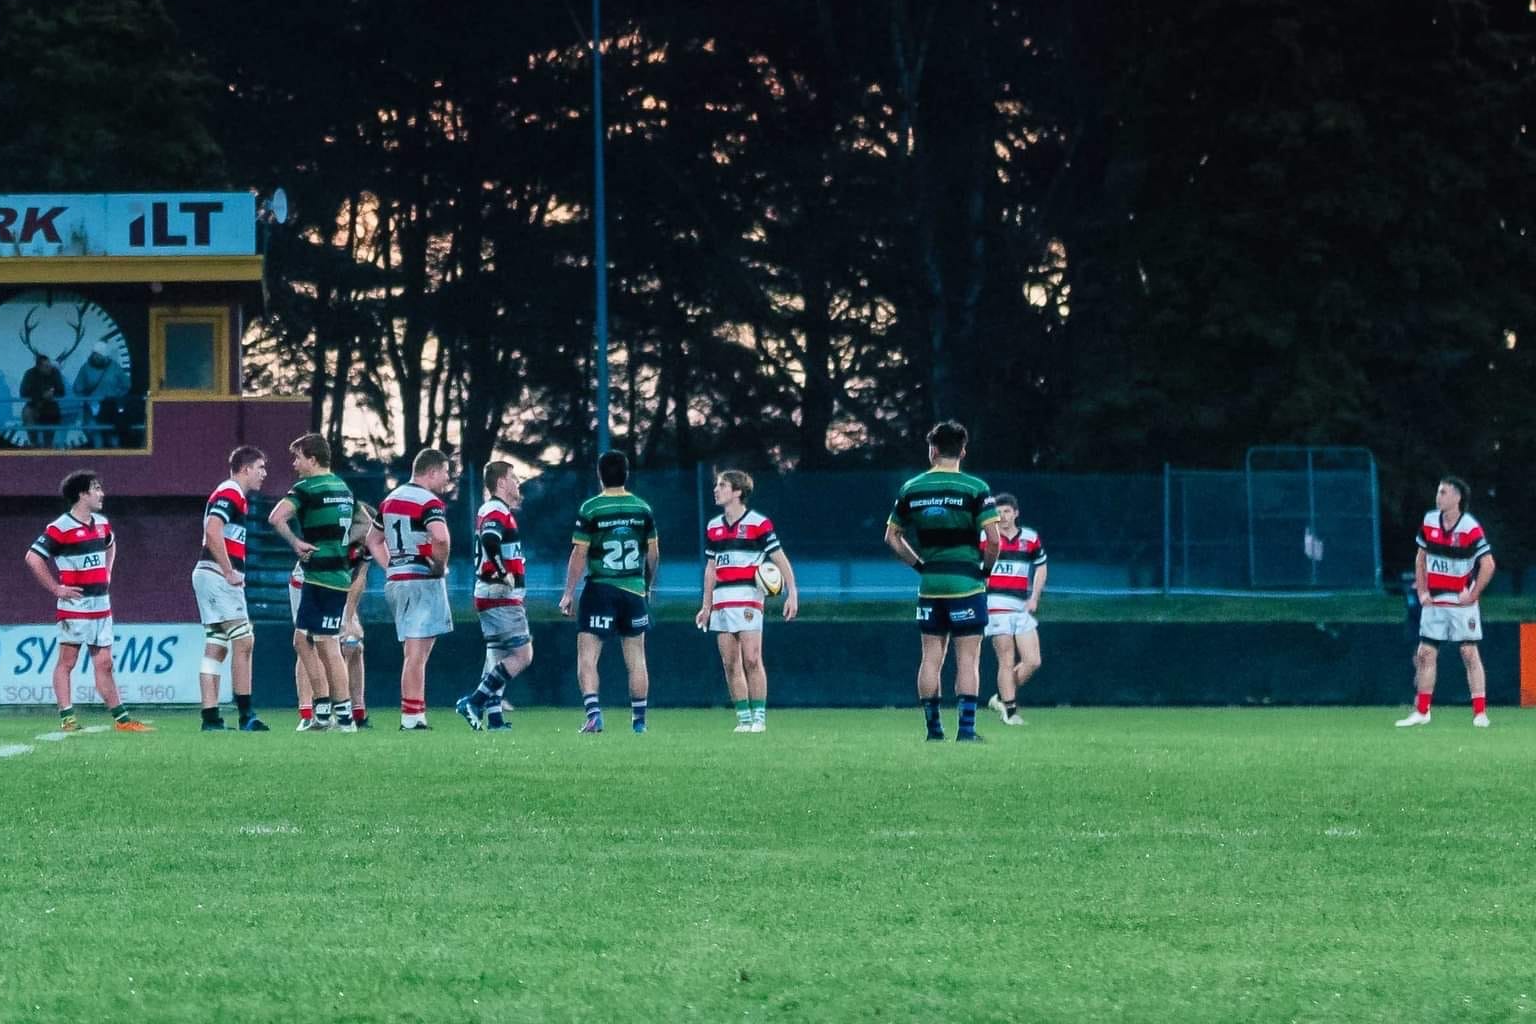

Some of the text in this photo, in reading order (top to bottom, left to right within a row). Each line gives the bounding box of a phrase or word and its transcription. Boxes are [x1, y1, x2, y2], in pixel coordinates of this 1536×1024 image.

[602, 540, 640, 570] 22
[589, 615, 613, 629] ILT
[916, 607, 933, 621] LT
[13, 635, 178, 675] SYMS
[5, 686, 55, 702] SOUT
[75, 686, 128, 702] SIE
[138, 685, 177, 701] 1960
